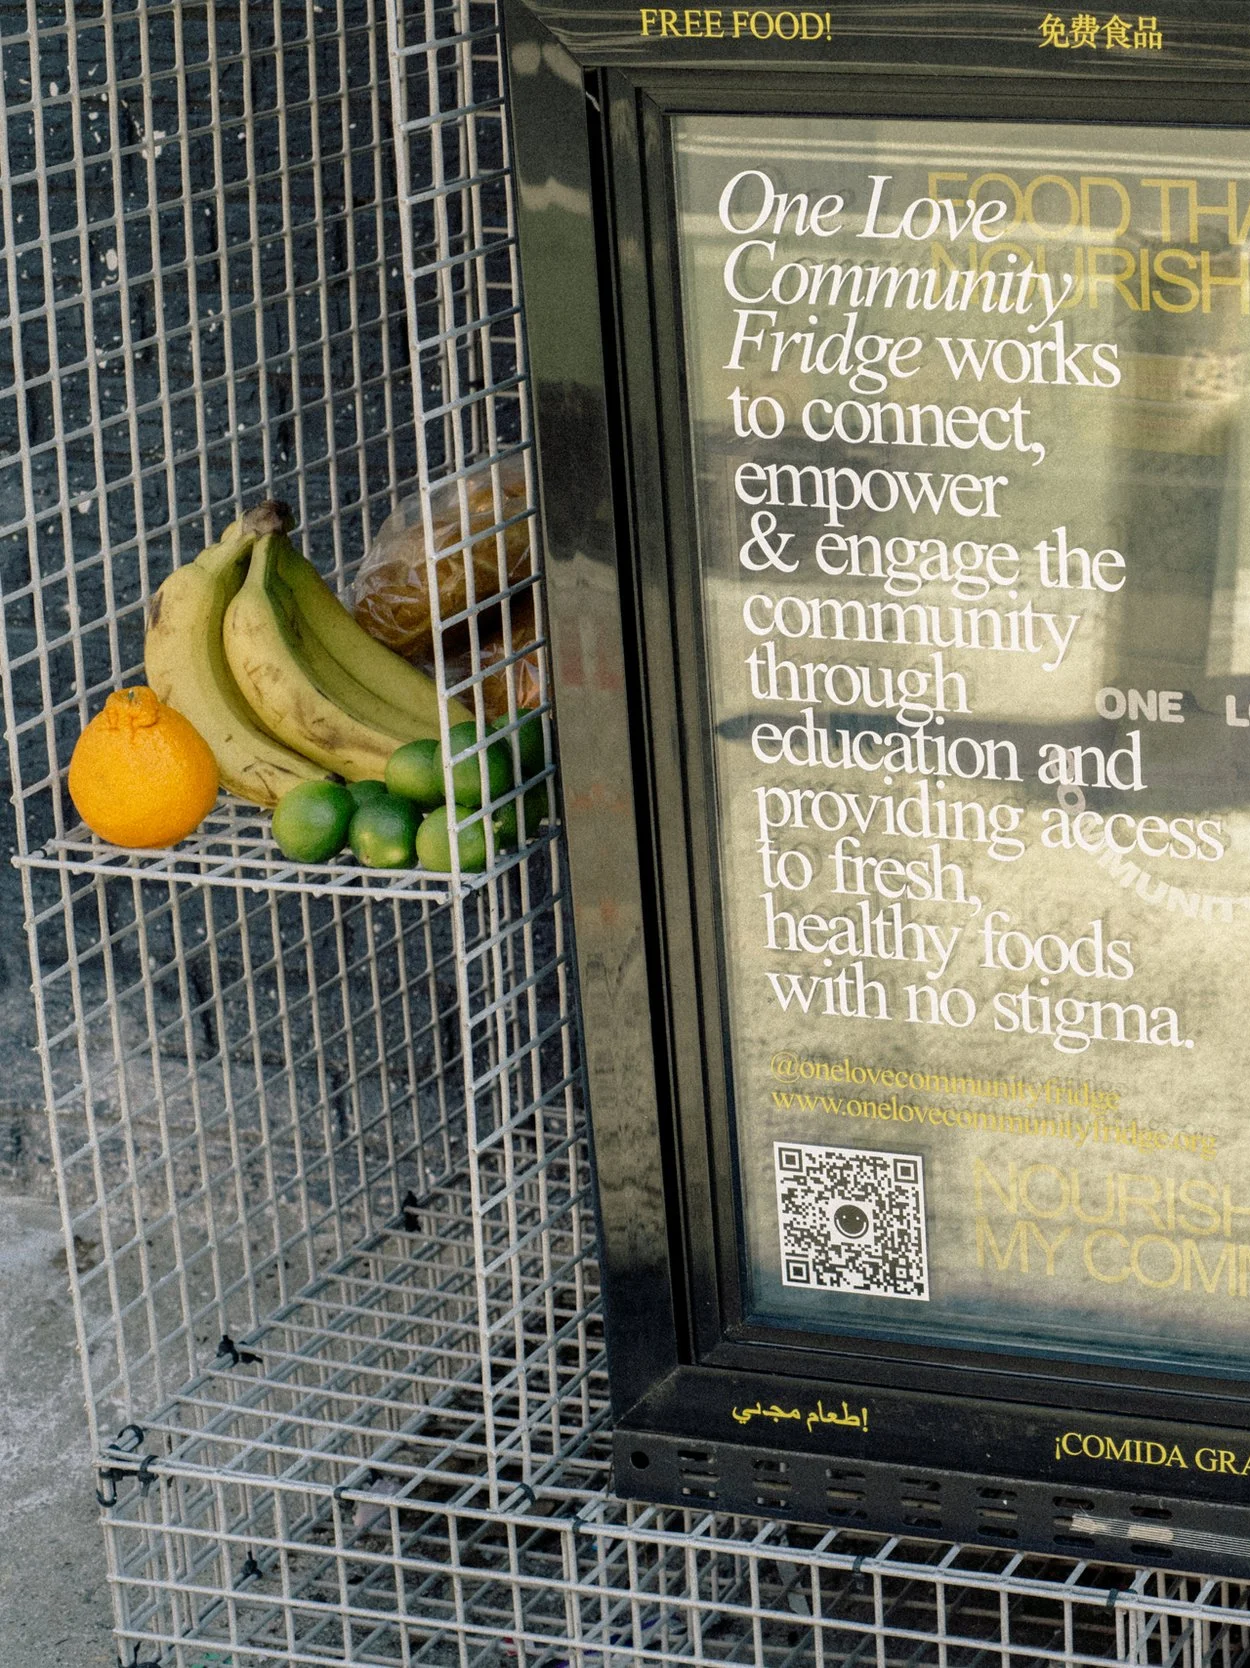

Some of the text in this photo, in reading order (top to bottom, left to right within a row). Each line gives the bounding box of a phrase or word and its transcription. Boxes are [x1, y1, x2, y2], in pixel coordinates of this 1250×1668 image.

[640, 8, 832, 41] FREE FOOD!
[1039, 13, 1163, 50] 免费食品
[718, 170, 1007, 243] One Love
[928, 171, 1131, 242] FOOD
[723, 240, 1074, 334] Community
[722, 309, 1121, 395] Fridge works
[727, 386, 1046, 466] to connect,
[734, 462, 1009, 528] empower
[739, 510, 1126, 601] & engage the
[742, 589, 1081, 673] community
[744, 640, 973, 728] through
[1094, 686, 1185, 724] ONE
[751, 709, 1148, 791] education and
[752, 777, 1225, 863] providing access
[756, 836, 984, 918] to fresh,
[759, 891, 1134, 981] healthy foods
[764, 958, 1195, 1055] with no stigma.
[771, 1051, 1121, 1114] @onelovecommunityfridge
[771, 1091, 1218, 1159] www.onelovecommunityfridge.org
[974, 1215, 1072, 1277] MY
[1055, 1432, 1188, 1469] ¡COMIDA
